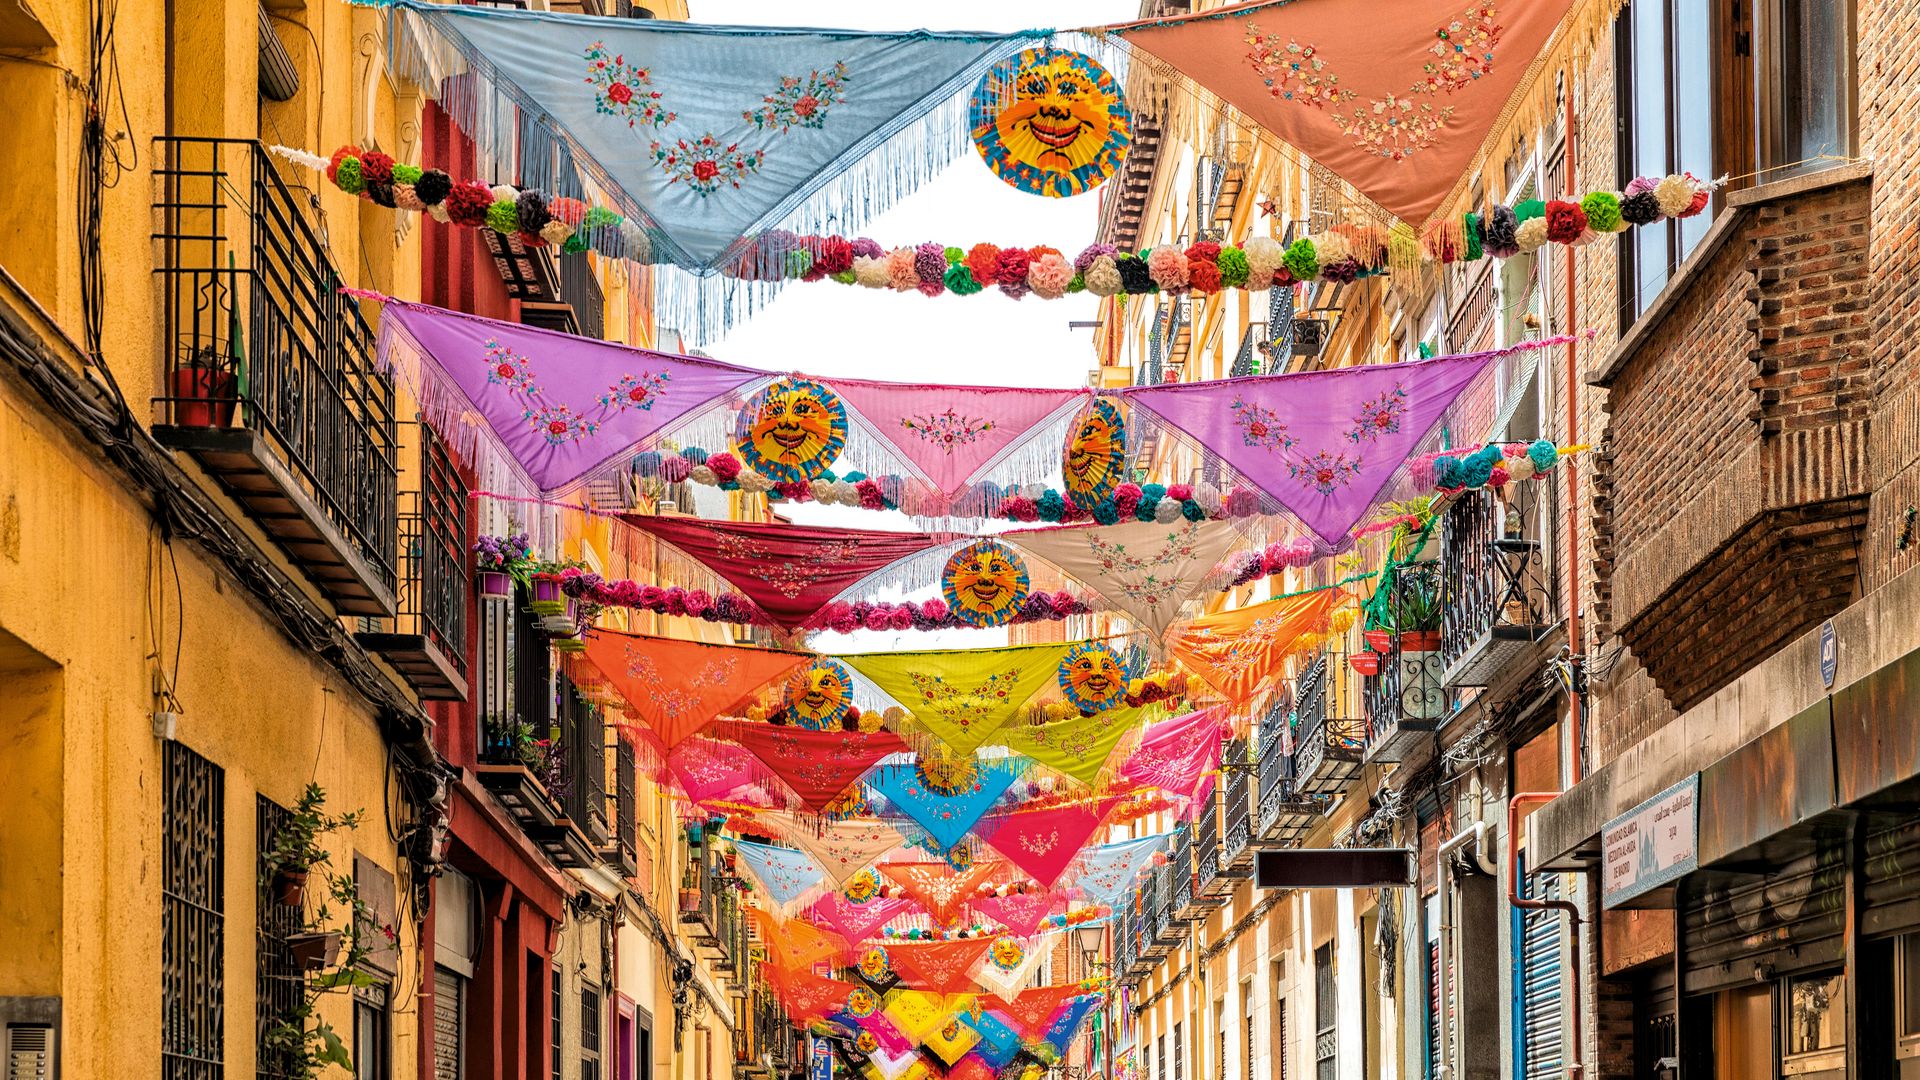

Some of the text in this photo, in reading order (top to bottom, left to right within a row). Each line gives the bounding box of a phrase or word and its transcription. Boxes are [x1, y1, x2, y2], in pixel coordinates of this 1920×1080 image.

[1823, 638, 1833, 663] ADT
[1606, 828, 1623, 848] COMUNIDAD
[1619, 861, 1630, 877] MADRID
